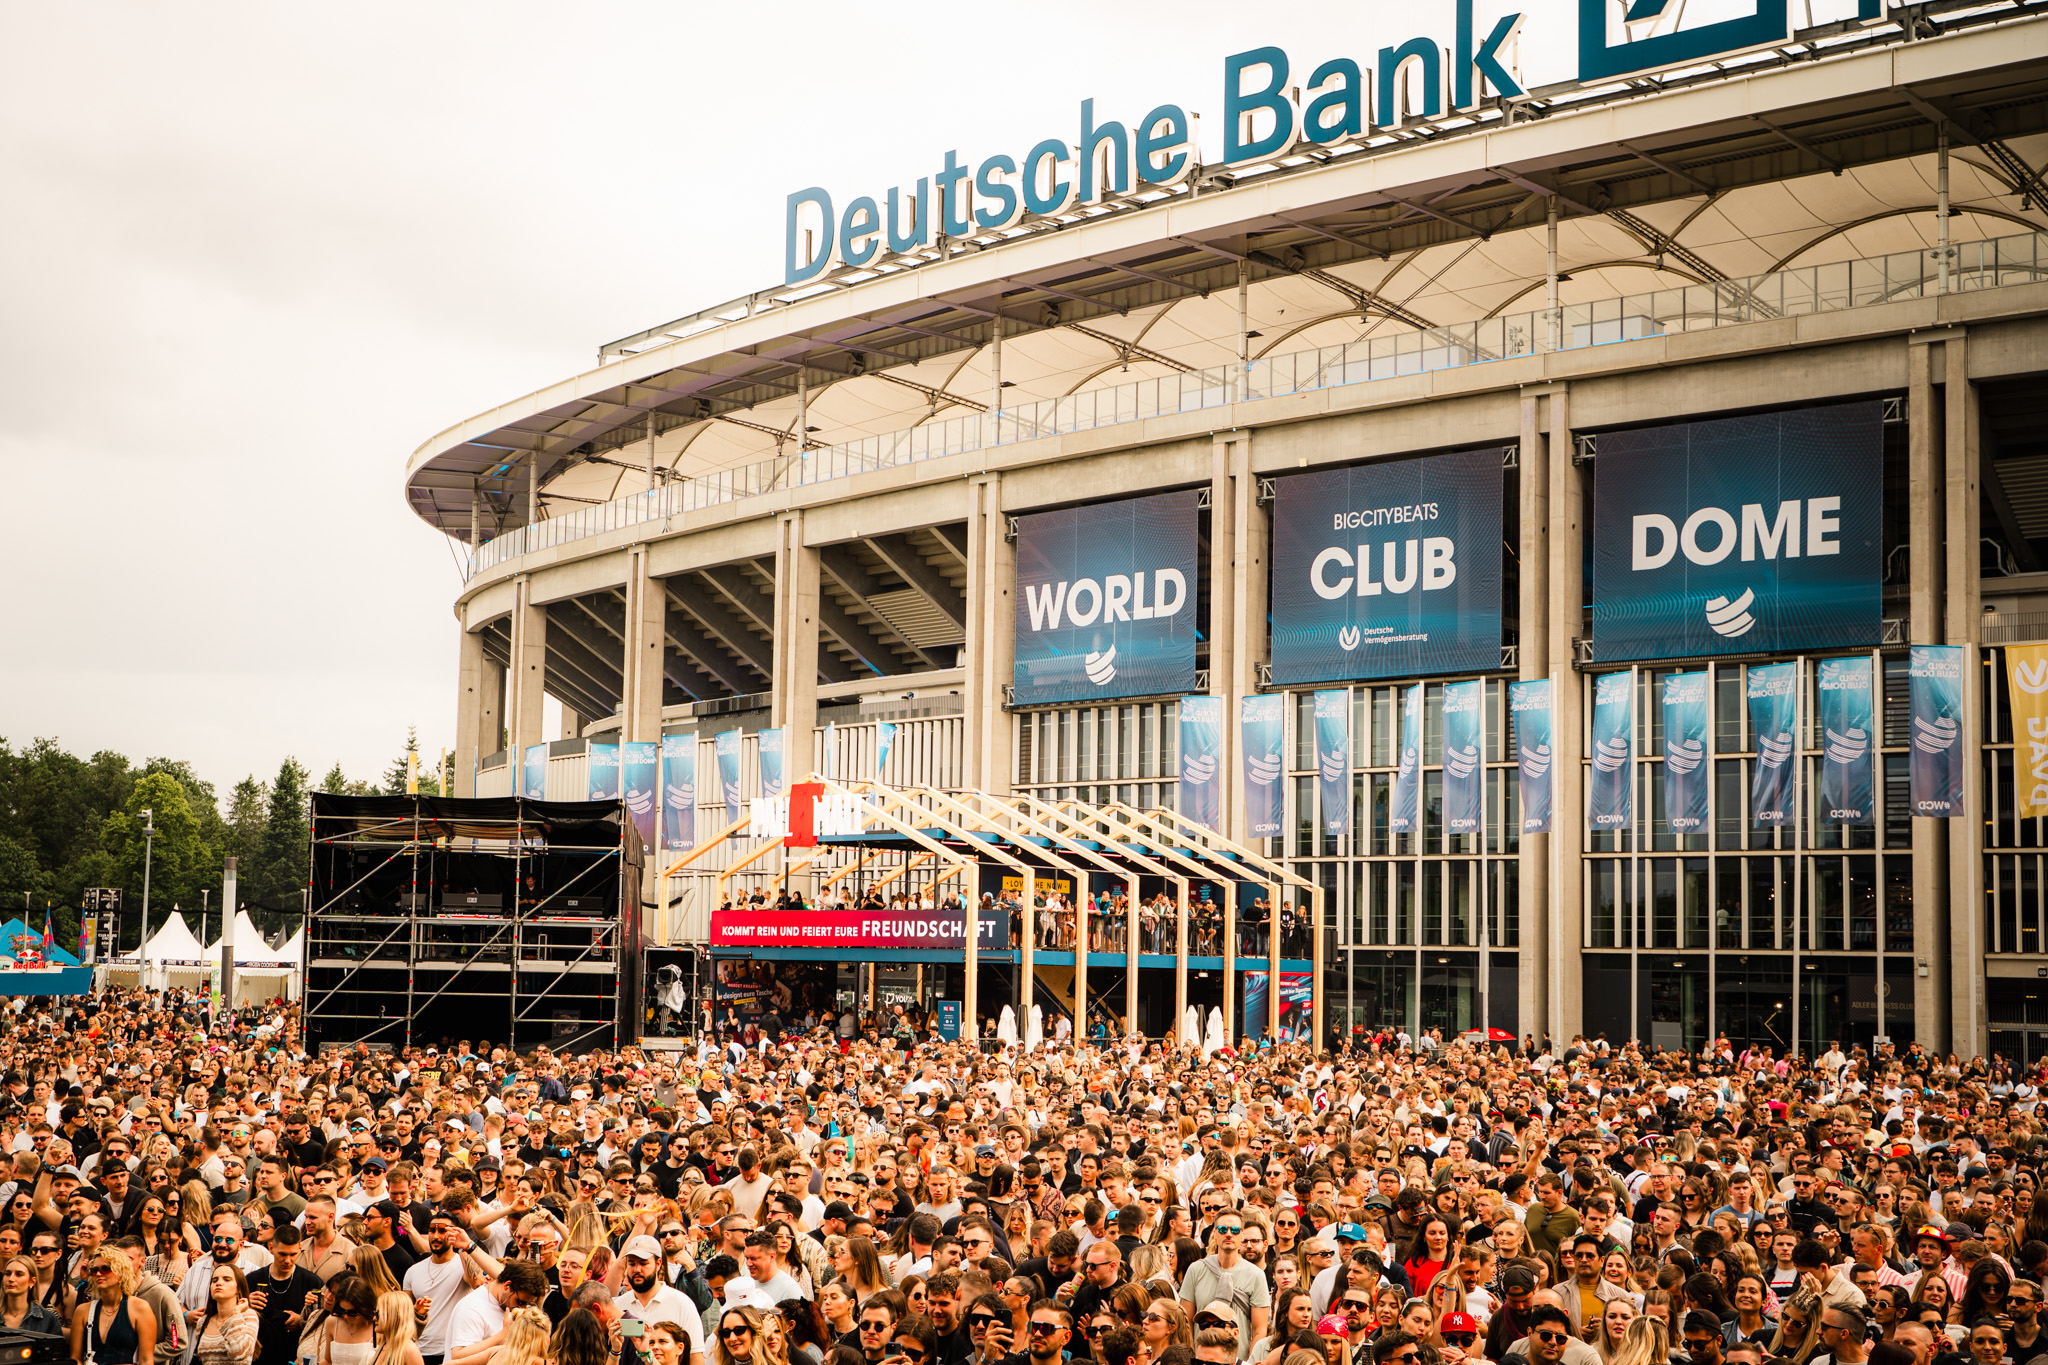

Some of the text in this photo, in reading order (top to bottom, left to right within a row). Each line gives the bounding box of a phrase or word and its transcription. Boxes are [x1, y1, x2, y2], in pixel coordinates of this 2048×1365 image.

[785, 0, 1528, 287] Deutsche Bank
[1333, 502, 1440, 531] BIGCITYBEATS
[1632, 495, 1841, 571] DOME
[1310, 536, 1457, 600] CLUB
[1025, 567, 1187, 632] WORLD
[1364, 626, 1394, 635] Deutsche
[1364, 633, 1428, 645] Vermögensberatung
[813, 793, 866, 836] MALL
[1010, 880, 1024, 888] LOV
[721, 920, 996, 938] KOMMT REIN UND FEIERT EURE FREUNDSCHFT
[13, 961, 44, 970] Red Bull
[722, 992, 743, 1000] designt
[755, 989, 773, 997] Tasche
[1900, 1002, 1914, 1010] CLUB
[1453, 1315, 1463, 1325] NY
